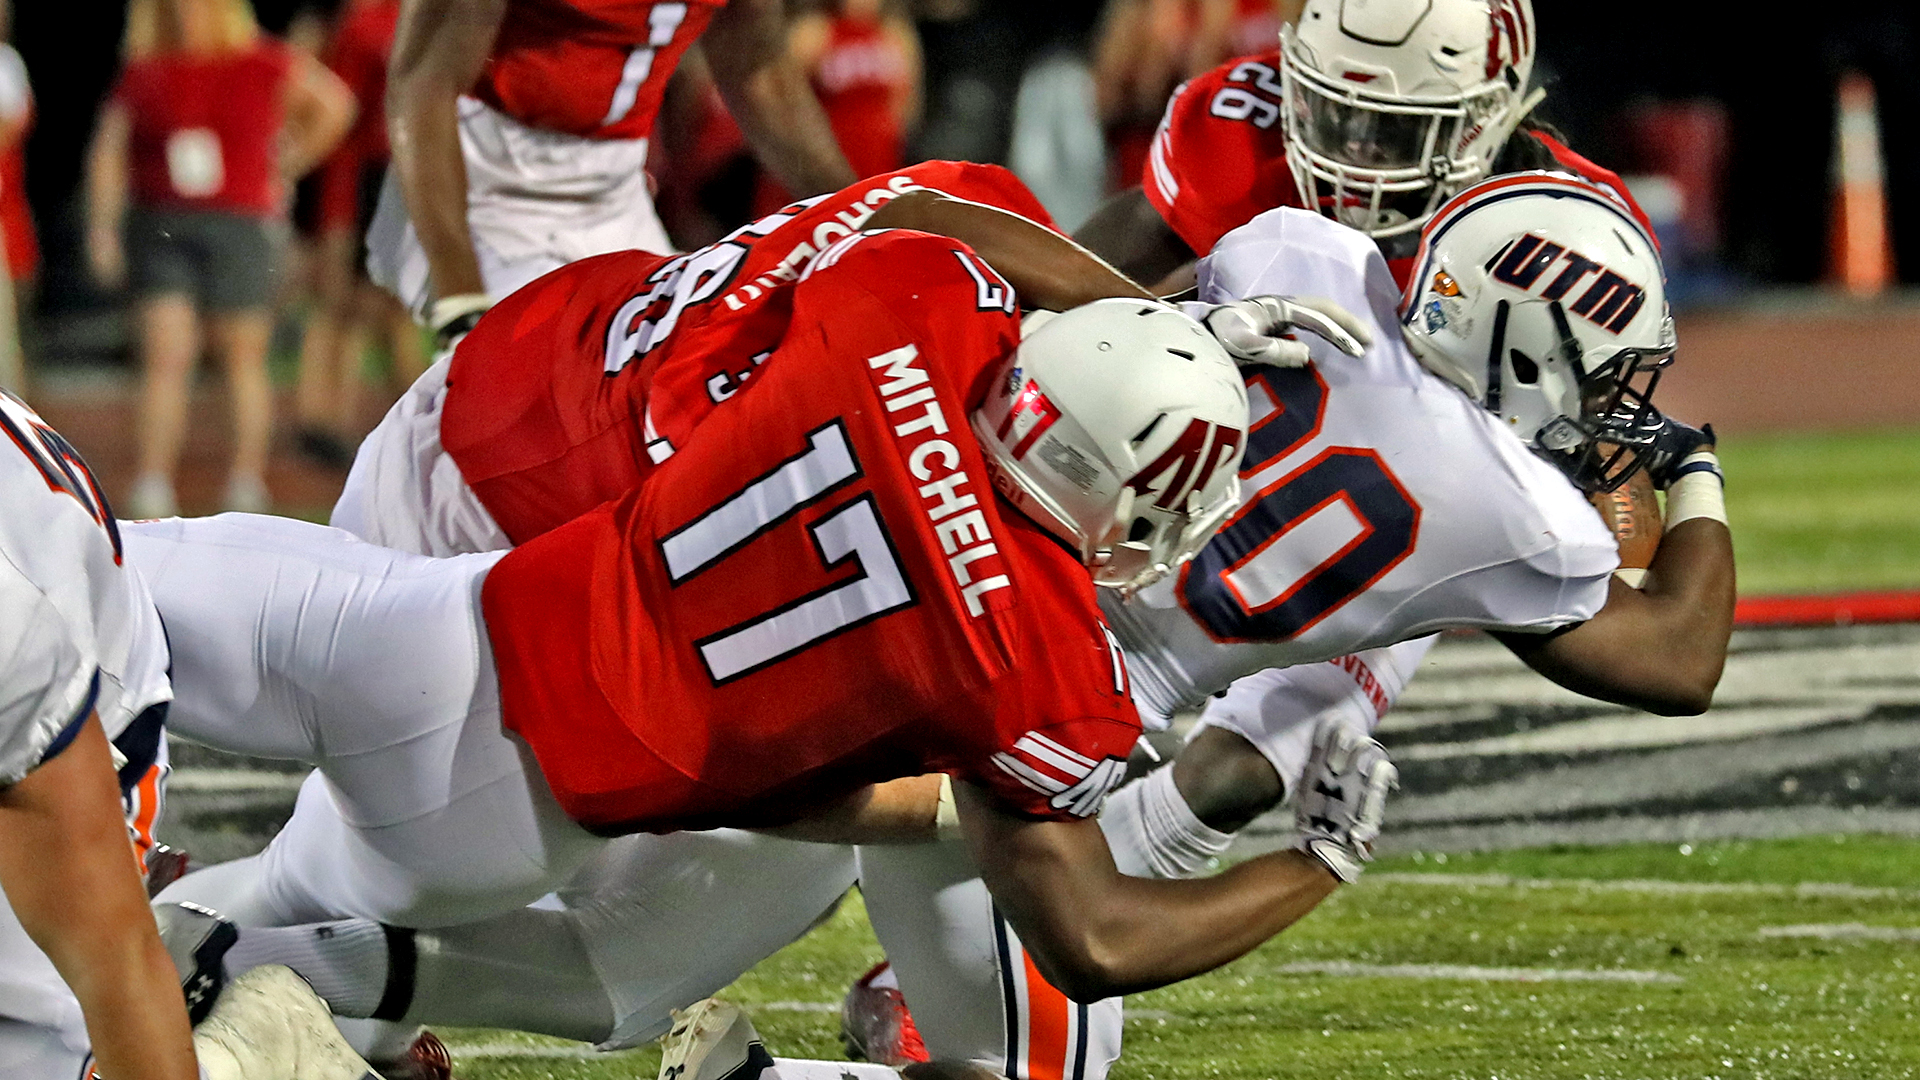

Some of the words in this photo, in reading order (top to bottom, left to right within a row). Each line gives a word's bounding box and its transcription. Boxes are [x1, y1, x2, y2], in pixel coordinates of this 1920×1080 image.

[1210, 61, 1283, 131] 26
[1493, 233, 1646, 336] UTM
[997, 378, 1063, 461] 17
[867, 343, 1011, 619] MITCHELL
[656, 416, 920, 688] 17
